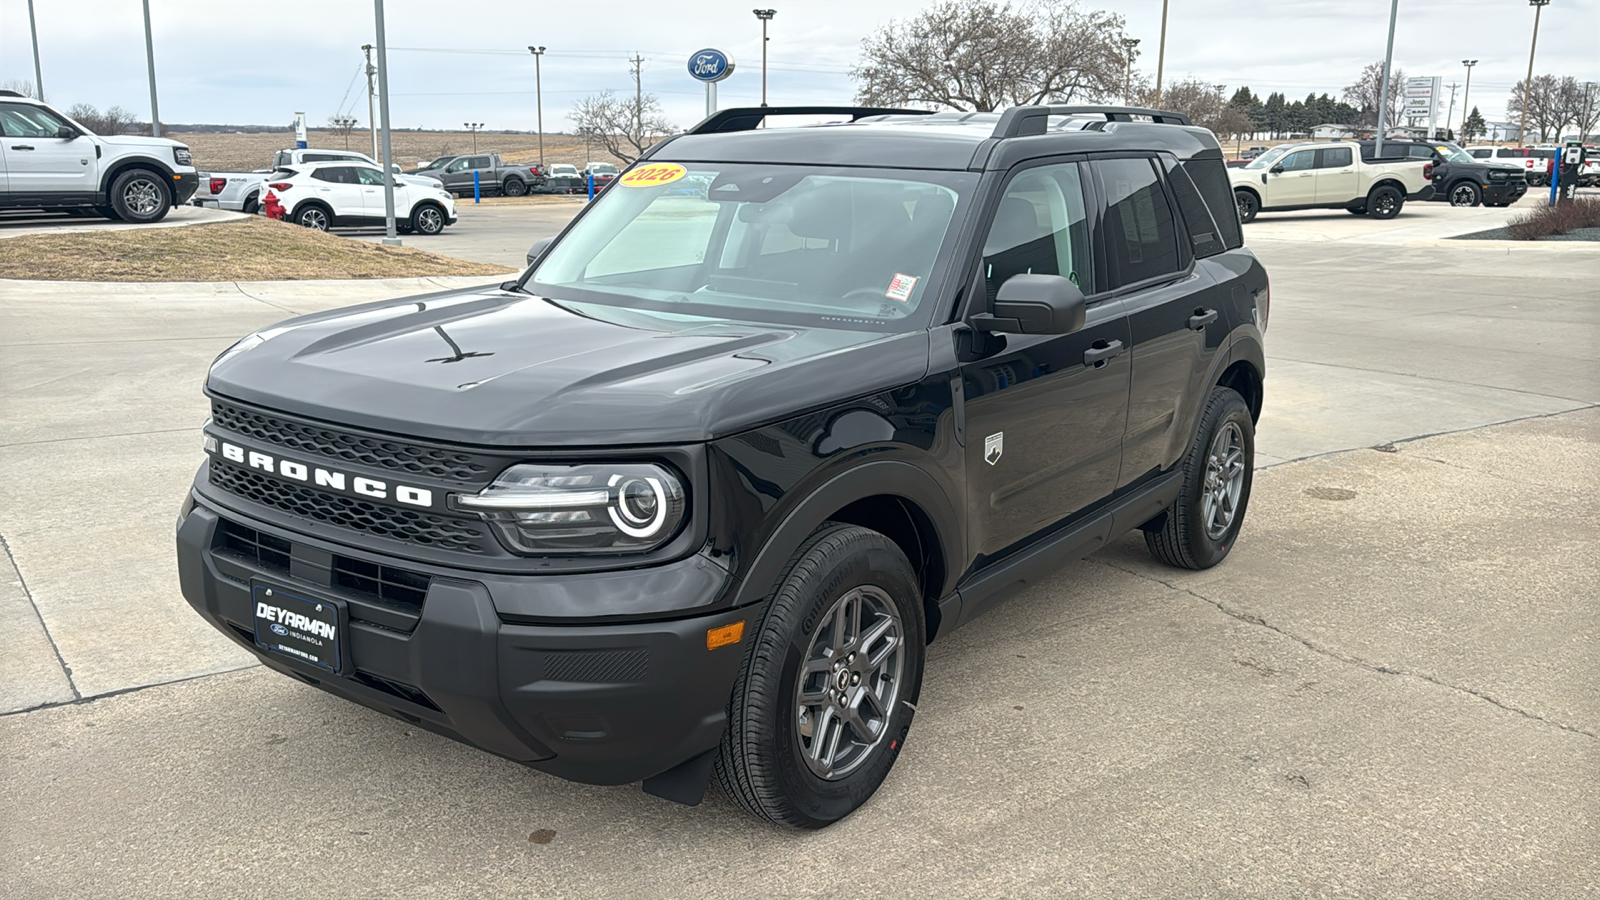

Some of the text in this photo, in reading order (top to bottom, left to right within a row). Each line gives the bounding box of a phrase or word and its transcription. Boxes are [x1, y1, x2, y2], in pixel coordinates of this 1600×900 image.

[695, 54, 719, 75] Ford
[623, 168, 681, 182] 2026
[222, 442, 432, 507] BRONCO
[801, 563, 853, 636] Continental
[256, 601, 336, 640] DEYARMAN
[289, 630, 323, 646] INDIANOLA
